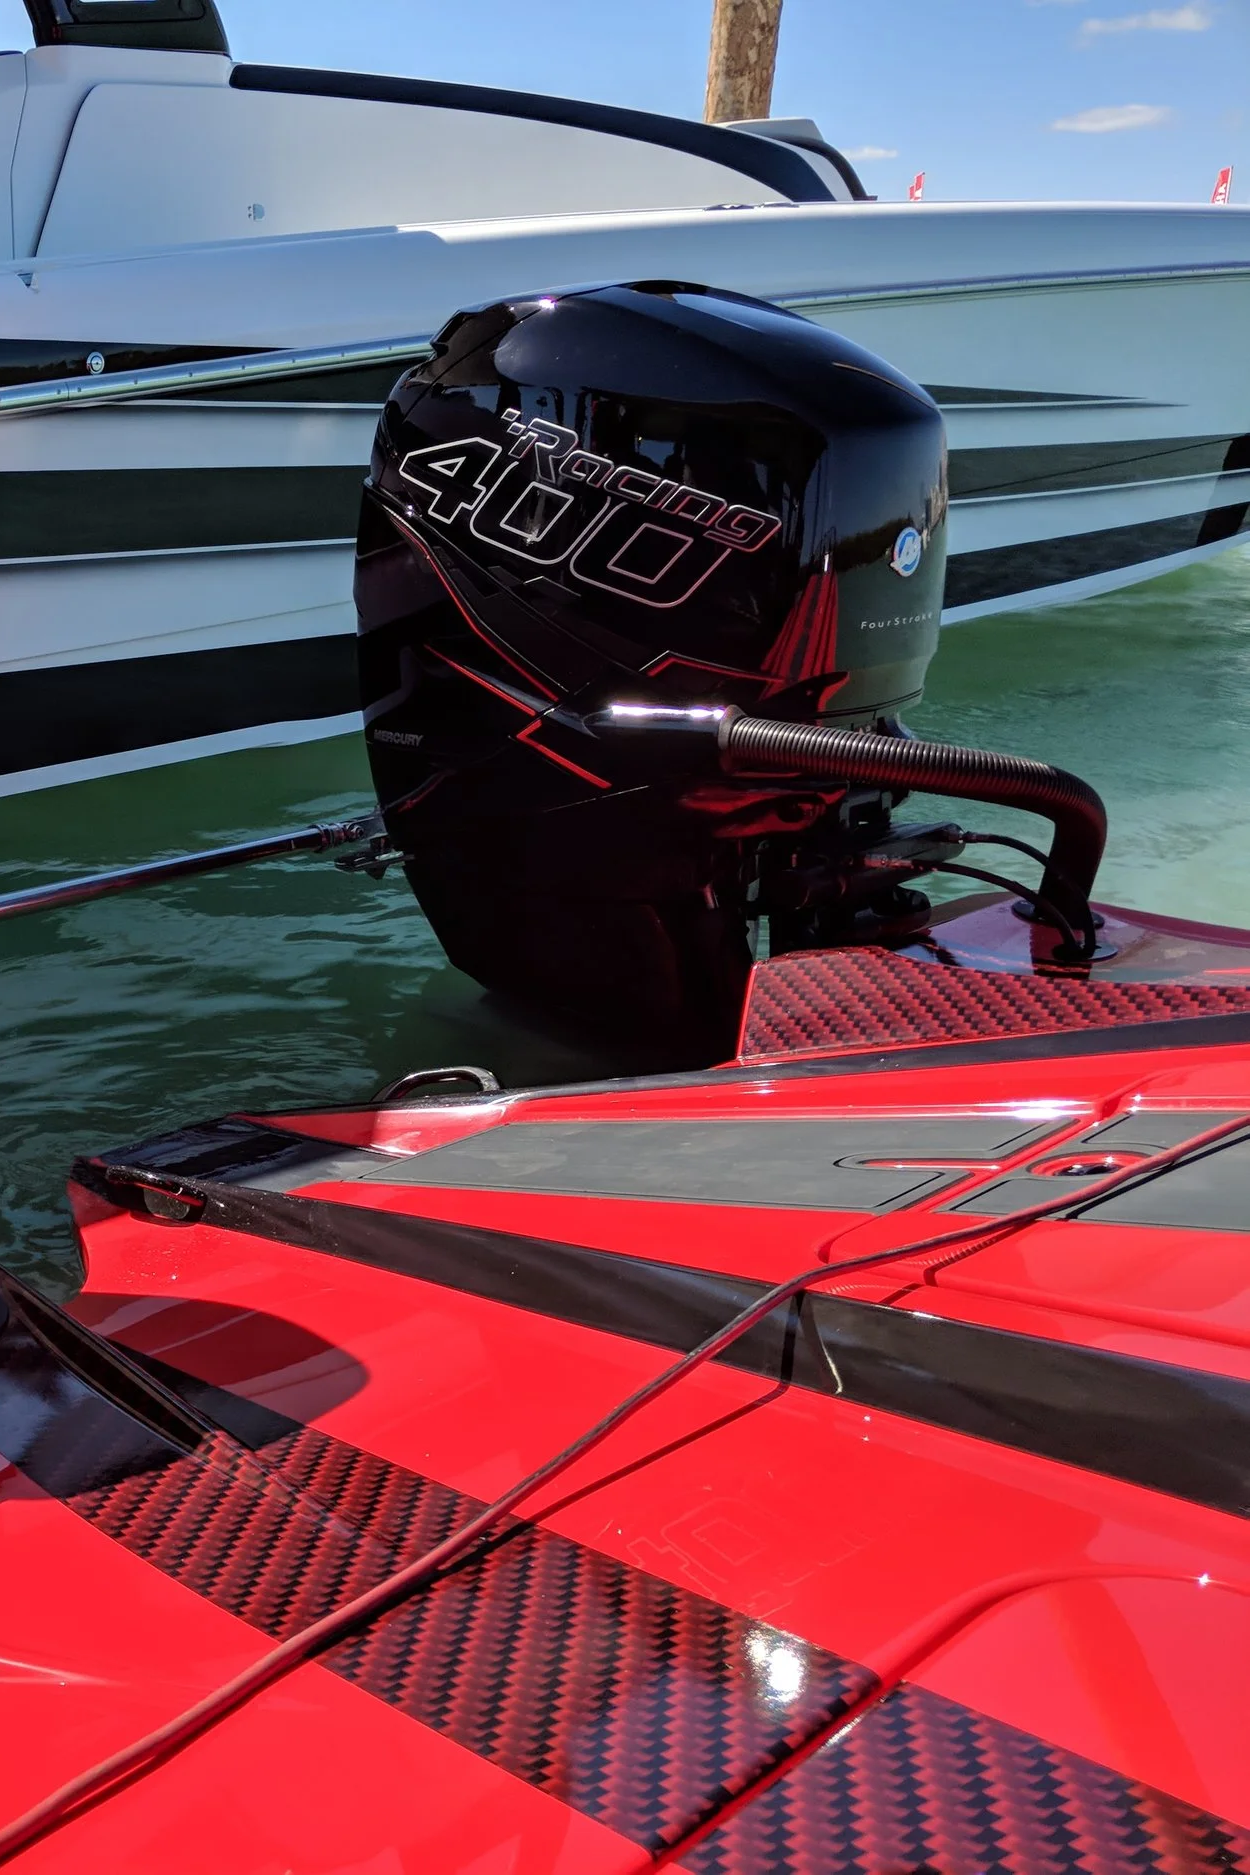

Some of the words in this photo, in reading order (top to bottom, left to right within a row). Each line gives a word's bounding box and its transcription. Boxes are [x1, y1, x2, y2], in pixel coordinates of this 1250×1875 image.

[399, 436, 732, 608] 400
[508, 417, 782, 553] Racing
[860, 611, 933, 630] FourStroke
[373, 728, 424, 747] MERCURY
